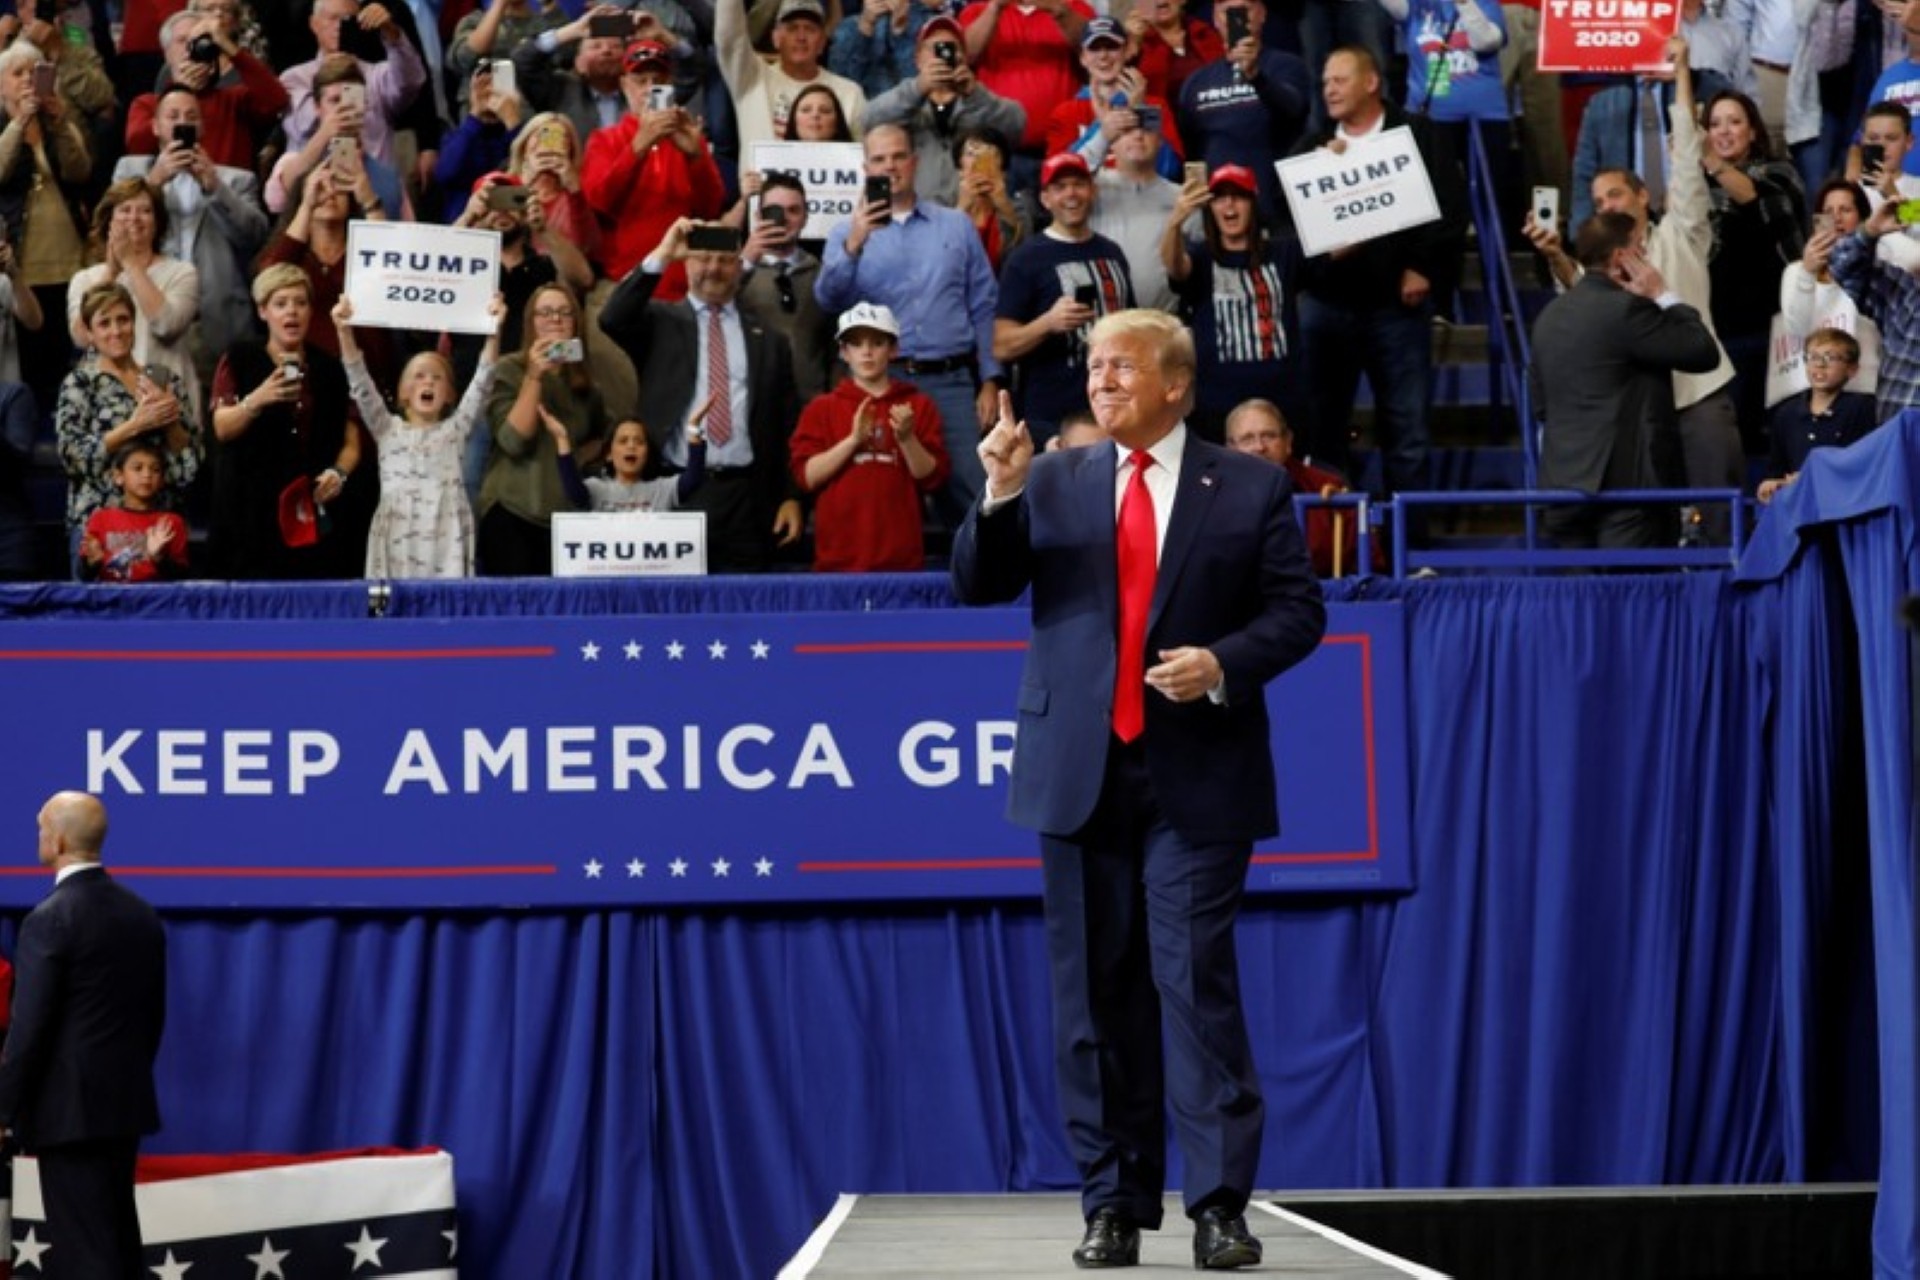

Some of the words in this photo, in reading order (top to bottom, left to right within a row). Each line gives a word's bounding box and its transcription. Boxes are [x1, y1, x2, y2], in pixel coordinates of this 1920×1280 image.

[1550, 0, 1674, 18] TRUMP
[1575, 31, 1641, 47] 2020
[1296, 154, 1411, 199] TRUMP
[1334, 192, 1396, 221] 2020
[359, 249, 489, 275] TRUMP
[386, 285, 456, 305] 2020
[564, 543, 694, 560] TRUMP
[86, 729, 341, 795] KEEP
[383, 723, 855, 794] AMERICA
